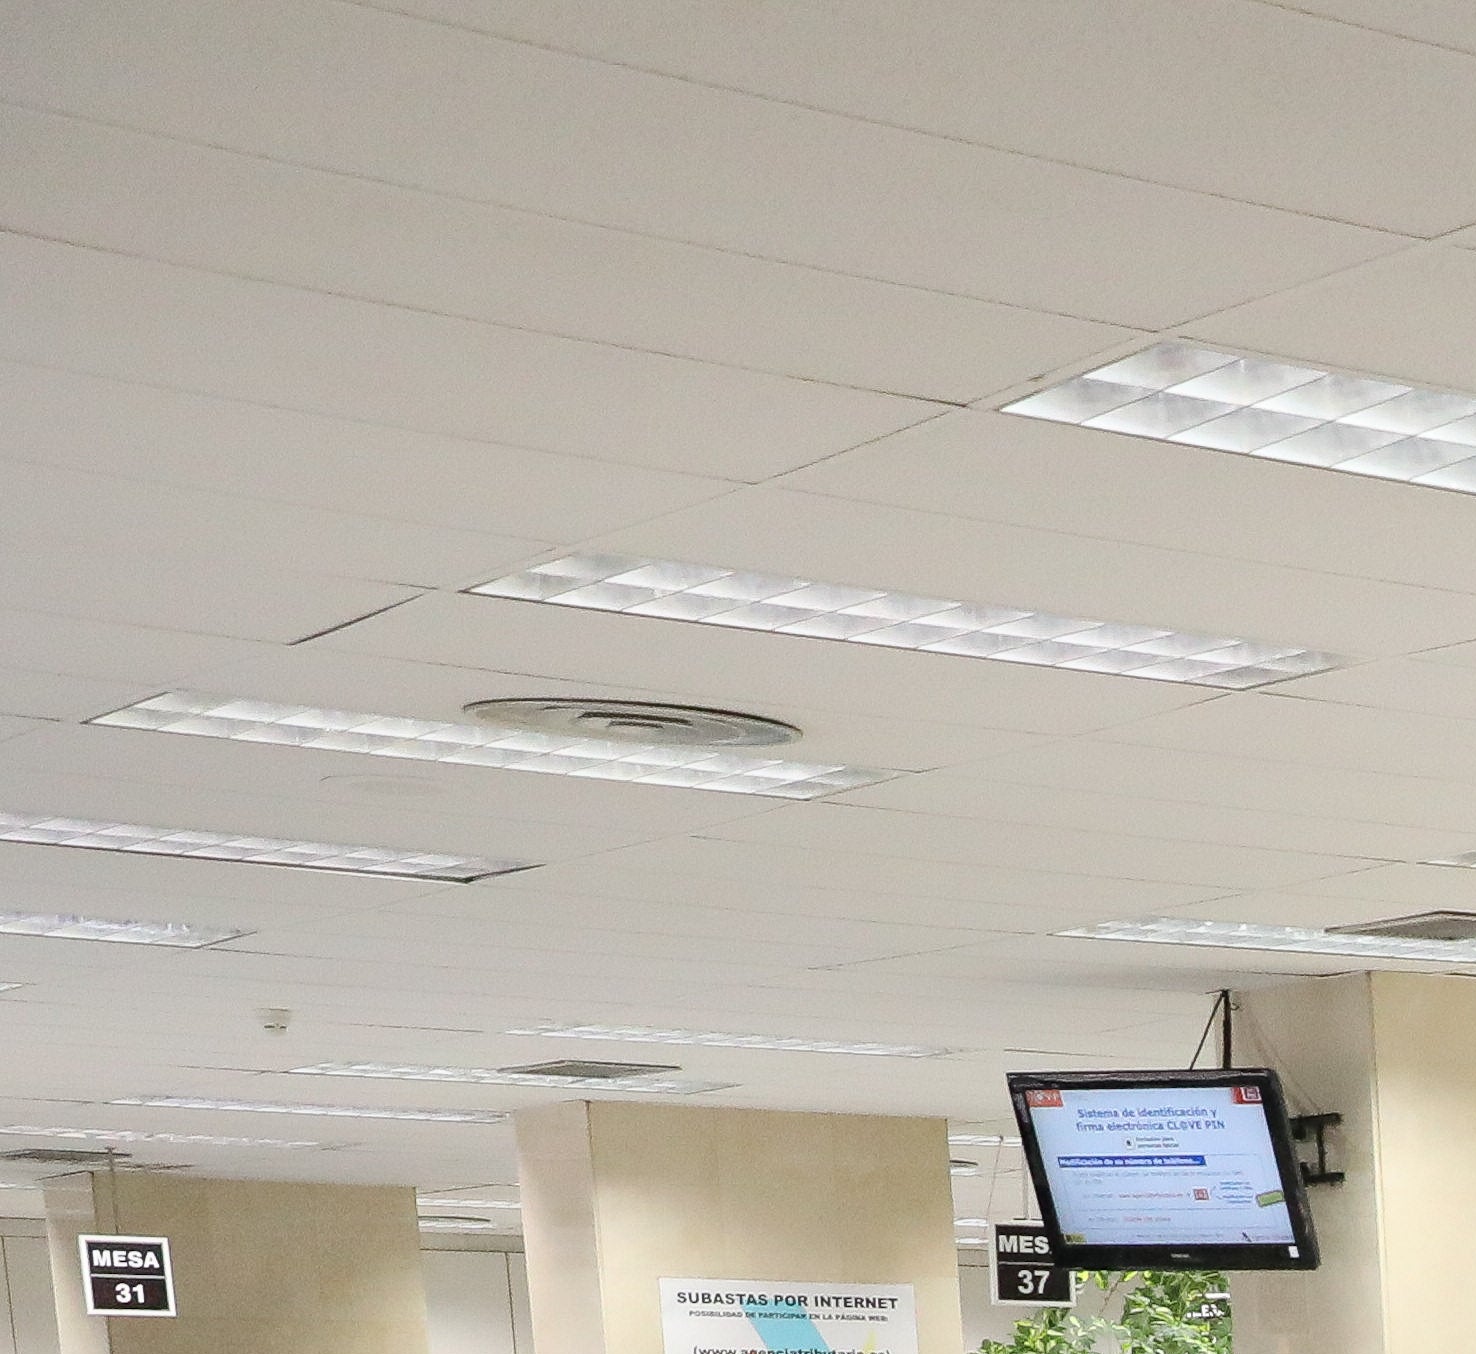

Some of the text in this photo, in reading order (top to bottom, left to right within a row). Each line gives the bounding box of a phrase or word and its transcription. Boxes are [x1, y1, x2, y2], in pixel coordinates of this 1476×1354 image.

[1077, 1106, 1217, 1119] Sistema de identificación y
[1076, 1122, 1104, 1132] firma
[1205, 1120, 1225, 1130] PIN
[998, 1234, 1053, 1255] MES
[92, 1249, 160, 1269] MESA
[1017, 1269, 1050, 1295] 37
[114, 1282, 145, 1304] 31
[677, 1291, 899, 1310] SUBASTAS POR INTERNET
[689, 1310, 743, 1318] POSIBILIDAD
